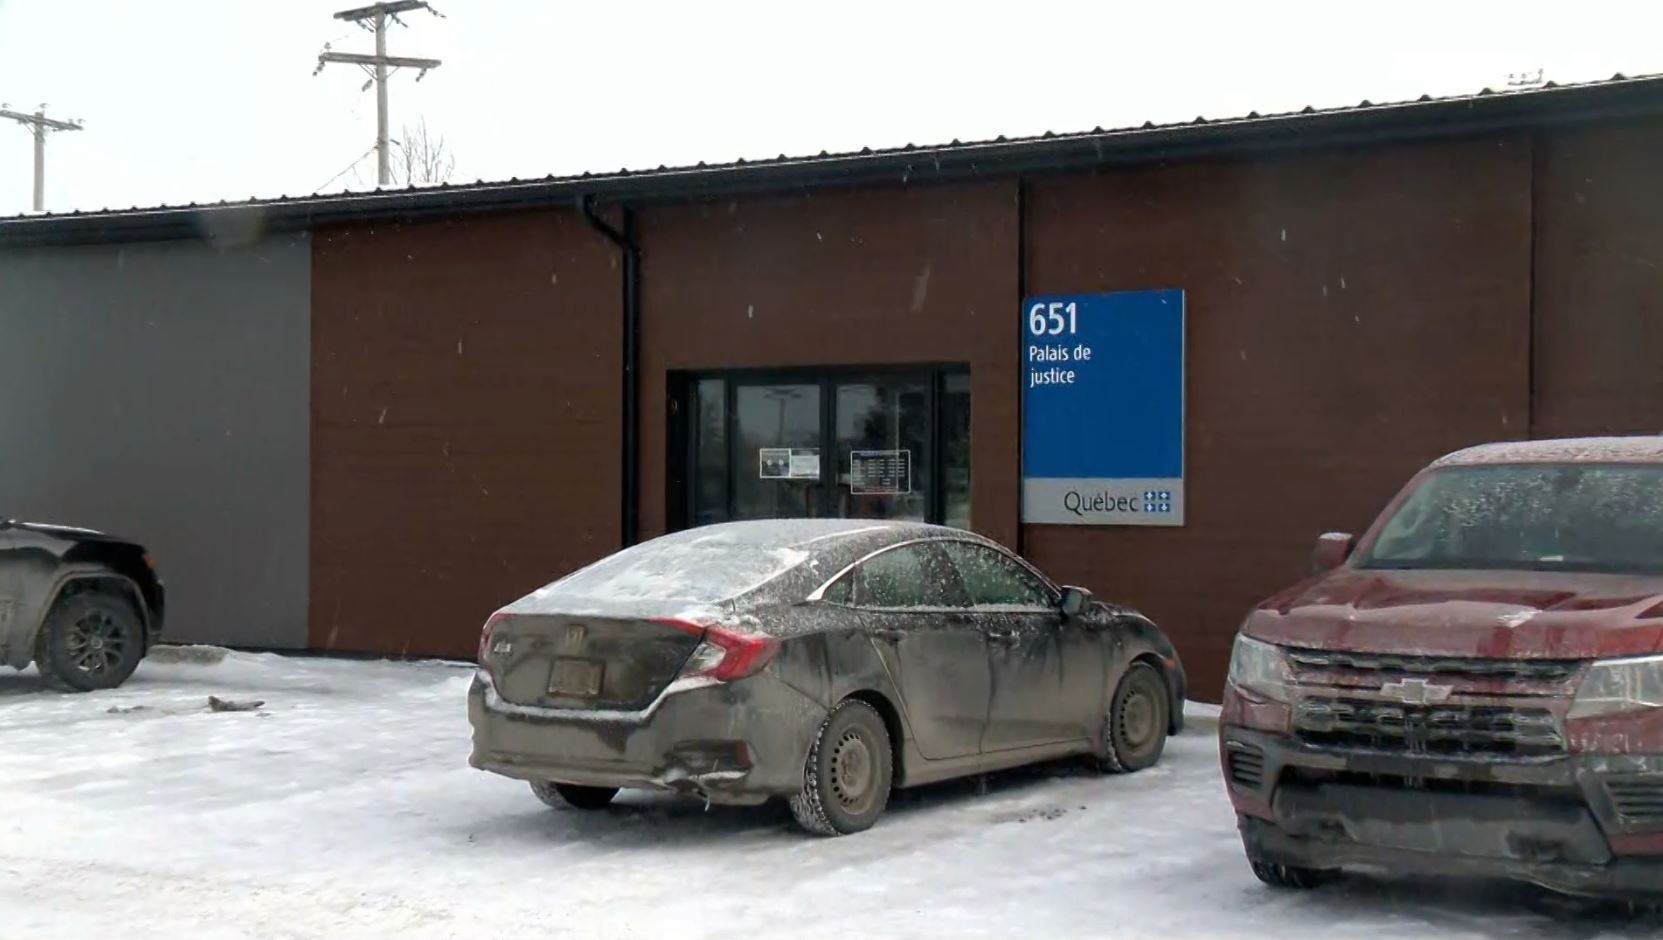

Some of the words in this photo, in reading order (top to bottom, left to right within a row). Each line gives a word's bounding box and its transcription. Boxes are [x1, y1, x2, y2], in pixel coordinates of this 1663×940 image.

[1029, 302, 1076, 336] 651
[1029, 344, 1070, 362] Palais
[1073, 344, 1091, 361] de
[1030, 367, 1075, 388] justice
[1064, 490, 1139, 516] Québec
